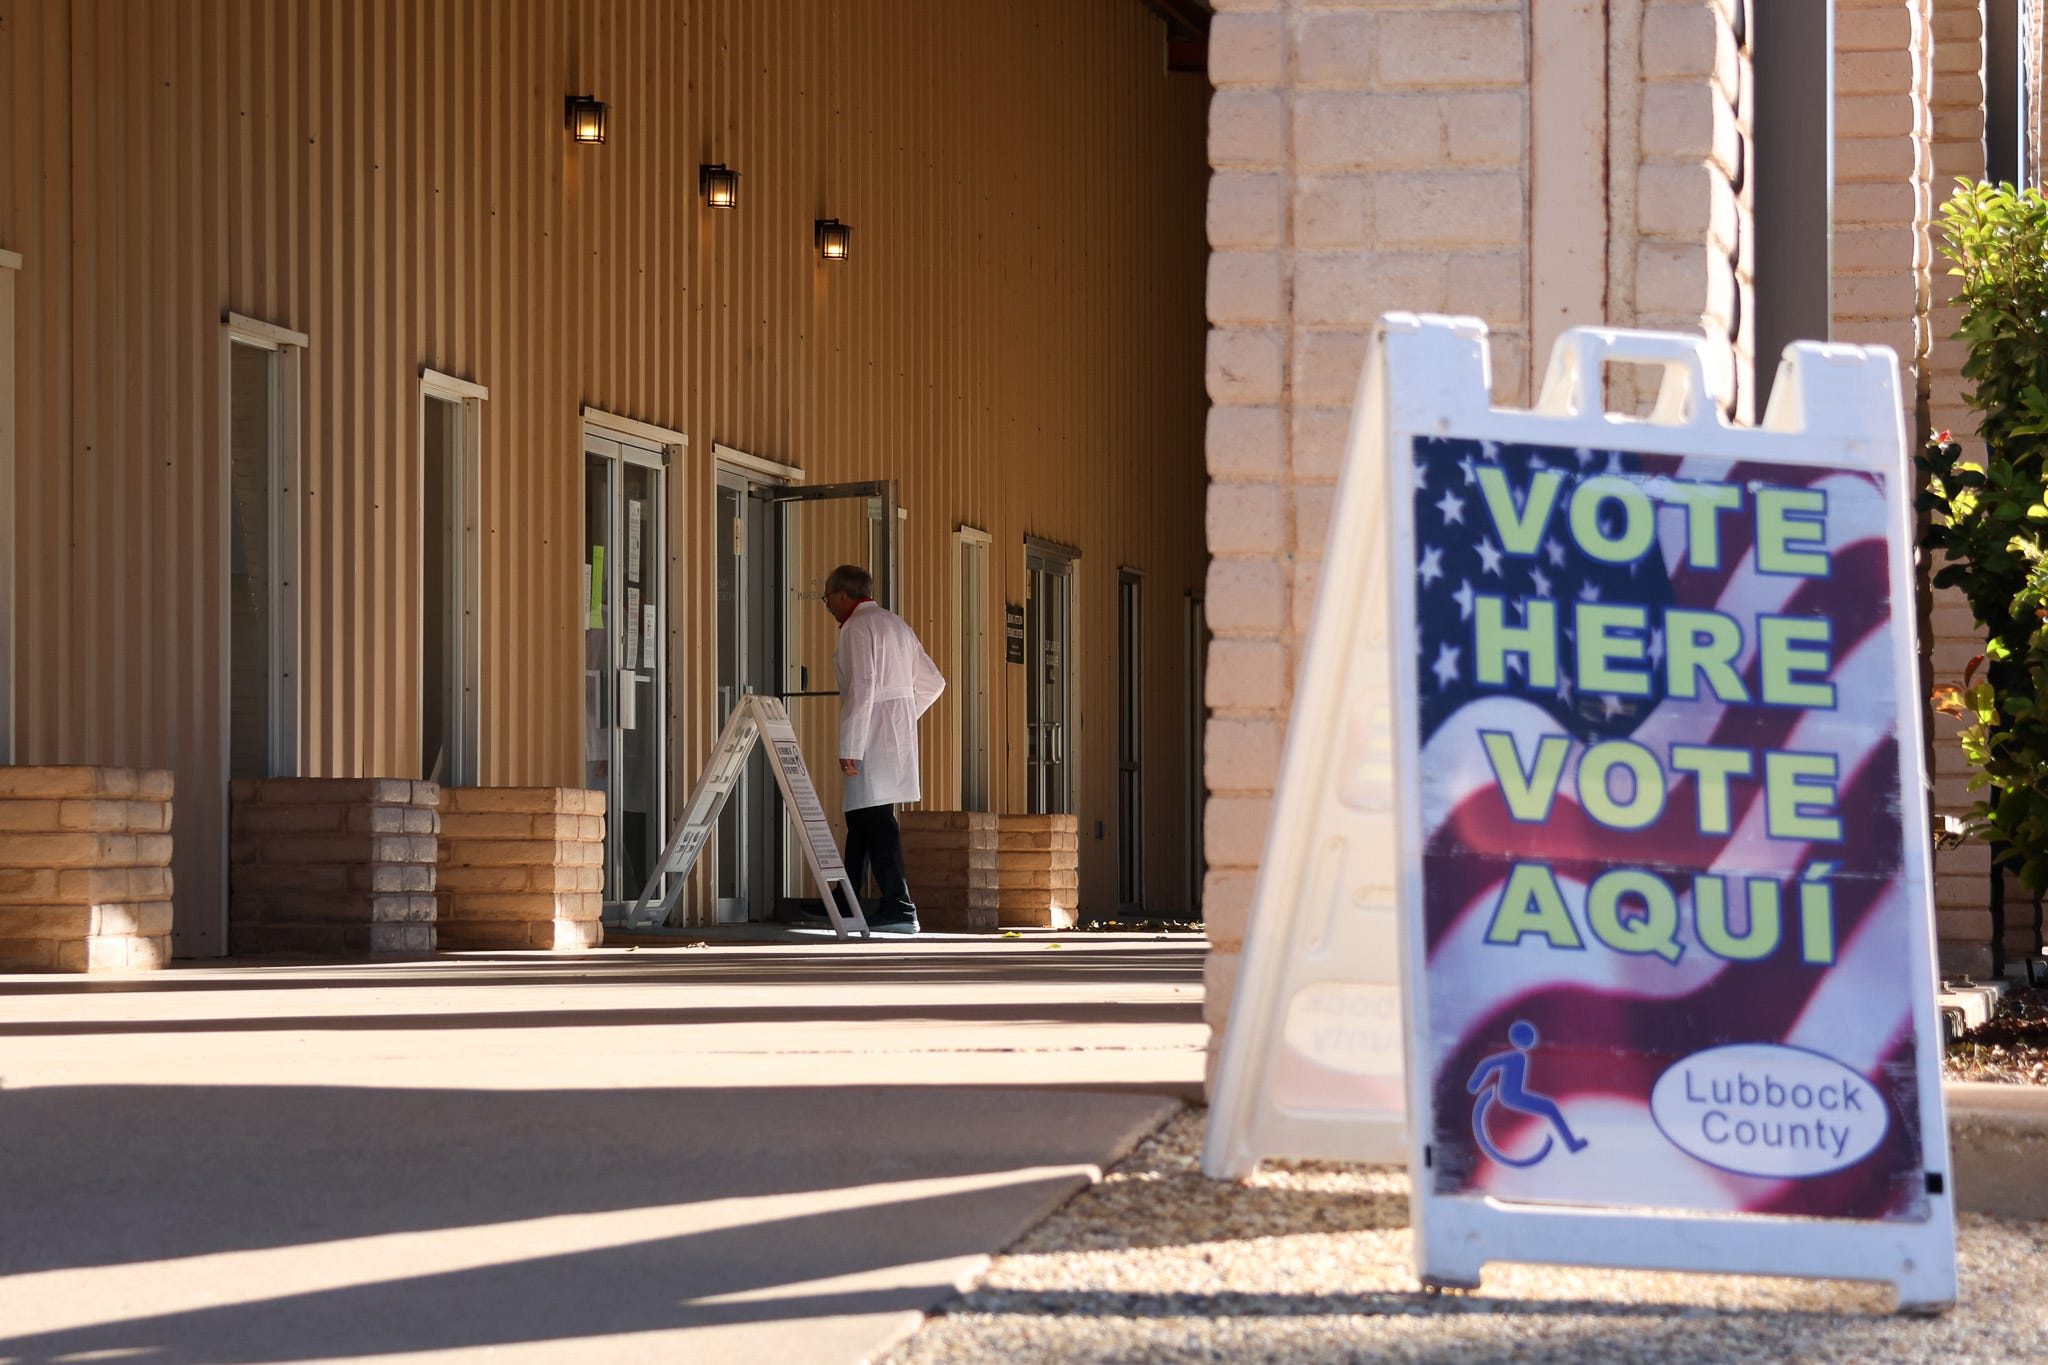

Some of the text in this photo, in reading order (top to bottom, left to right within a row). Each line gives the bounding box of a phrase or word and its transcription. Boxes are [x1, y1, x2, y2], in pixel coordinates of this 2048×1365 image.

[1474, 463, 1832, 578] VOTE
[1472, 594, 1837, 708] HERE
[1477, 729, 1846, 843] VOTE
[1482, 860, 1844, 967] AQUÍ
[1684, 1069, 1864, 1112] Lubbock
[1701, 1110, 1850, 1159] County
